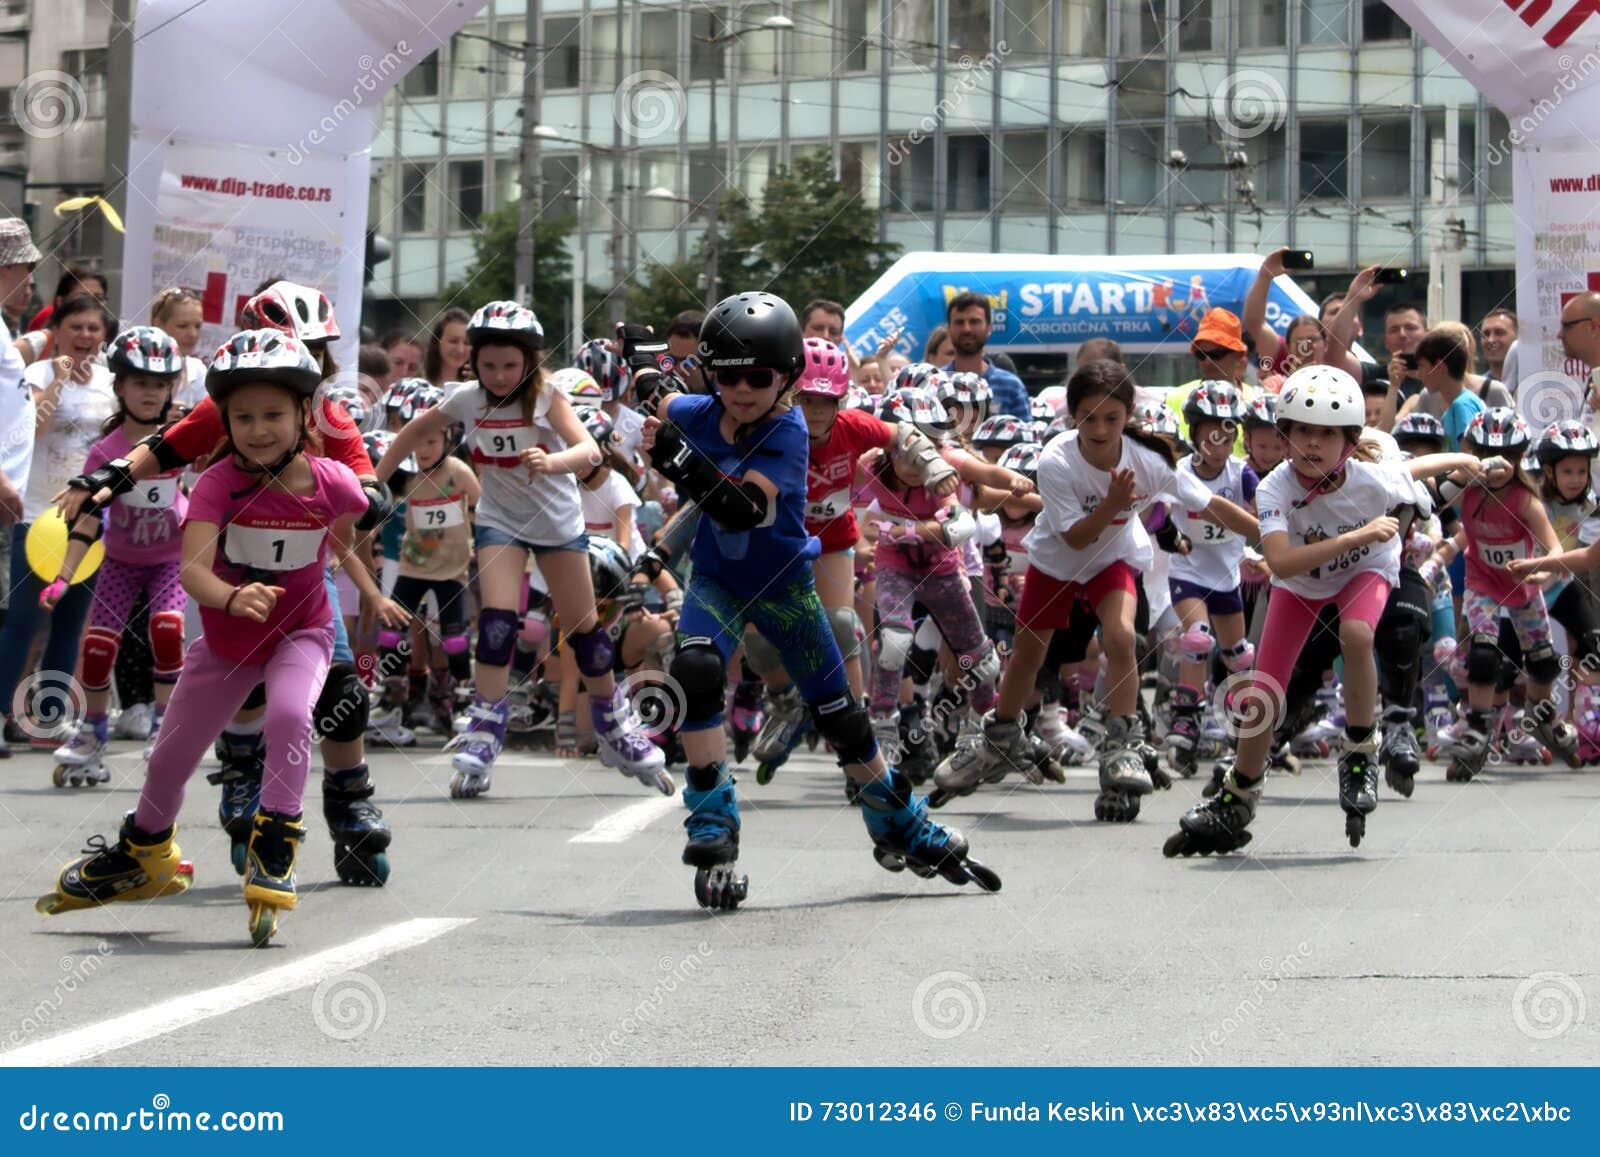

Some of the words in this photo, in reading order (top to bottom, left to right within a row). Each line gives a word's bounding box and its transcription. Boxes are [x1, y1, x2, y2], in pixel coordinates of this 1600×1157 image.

[181, 173, 332, 202] www.dip-trade.co.rs
[1019, 282, 1152, 316] START
[1112, 320, 1152, 333] TRKA
[493, 435, 516, 452] 91
[147, 486, 160, 503] 6
[425, 510, 446, 525] 79
[1204, 524, 1226, 540] 32
[271, 539, 286, 563] 1
